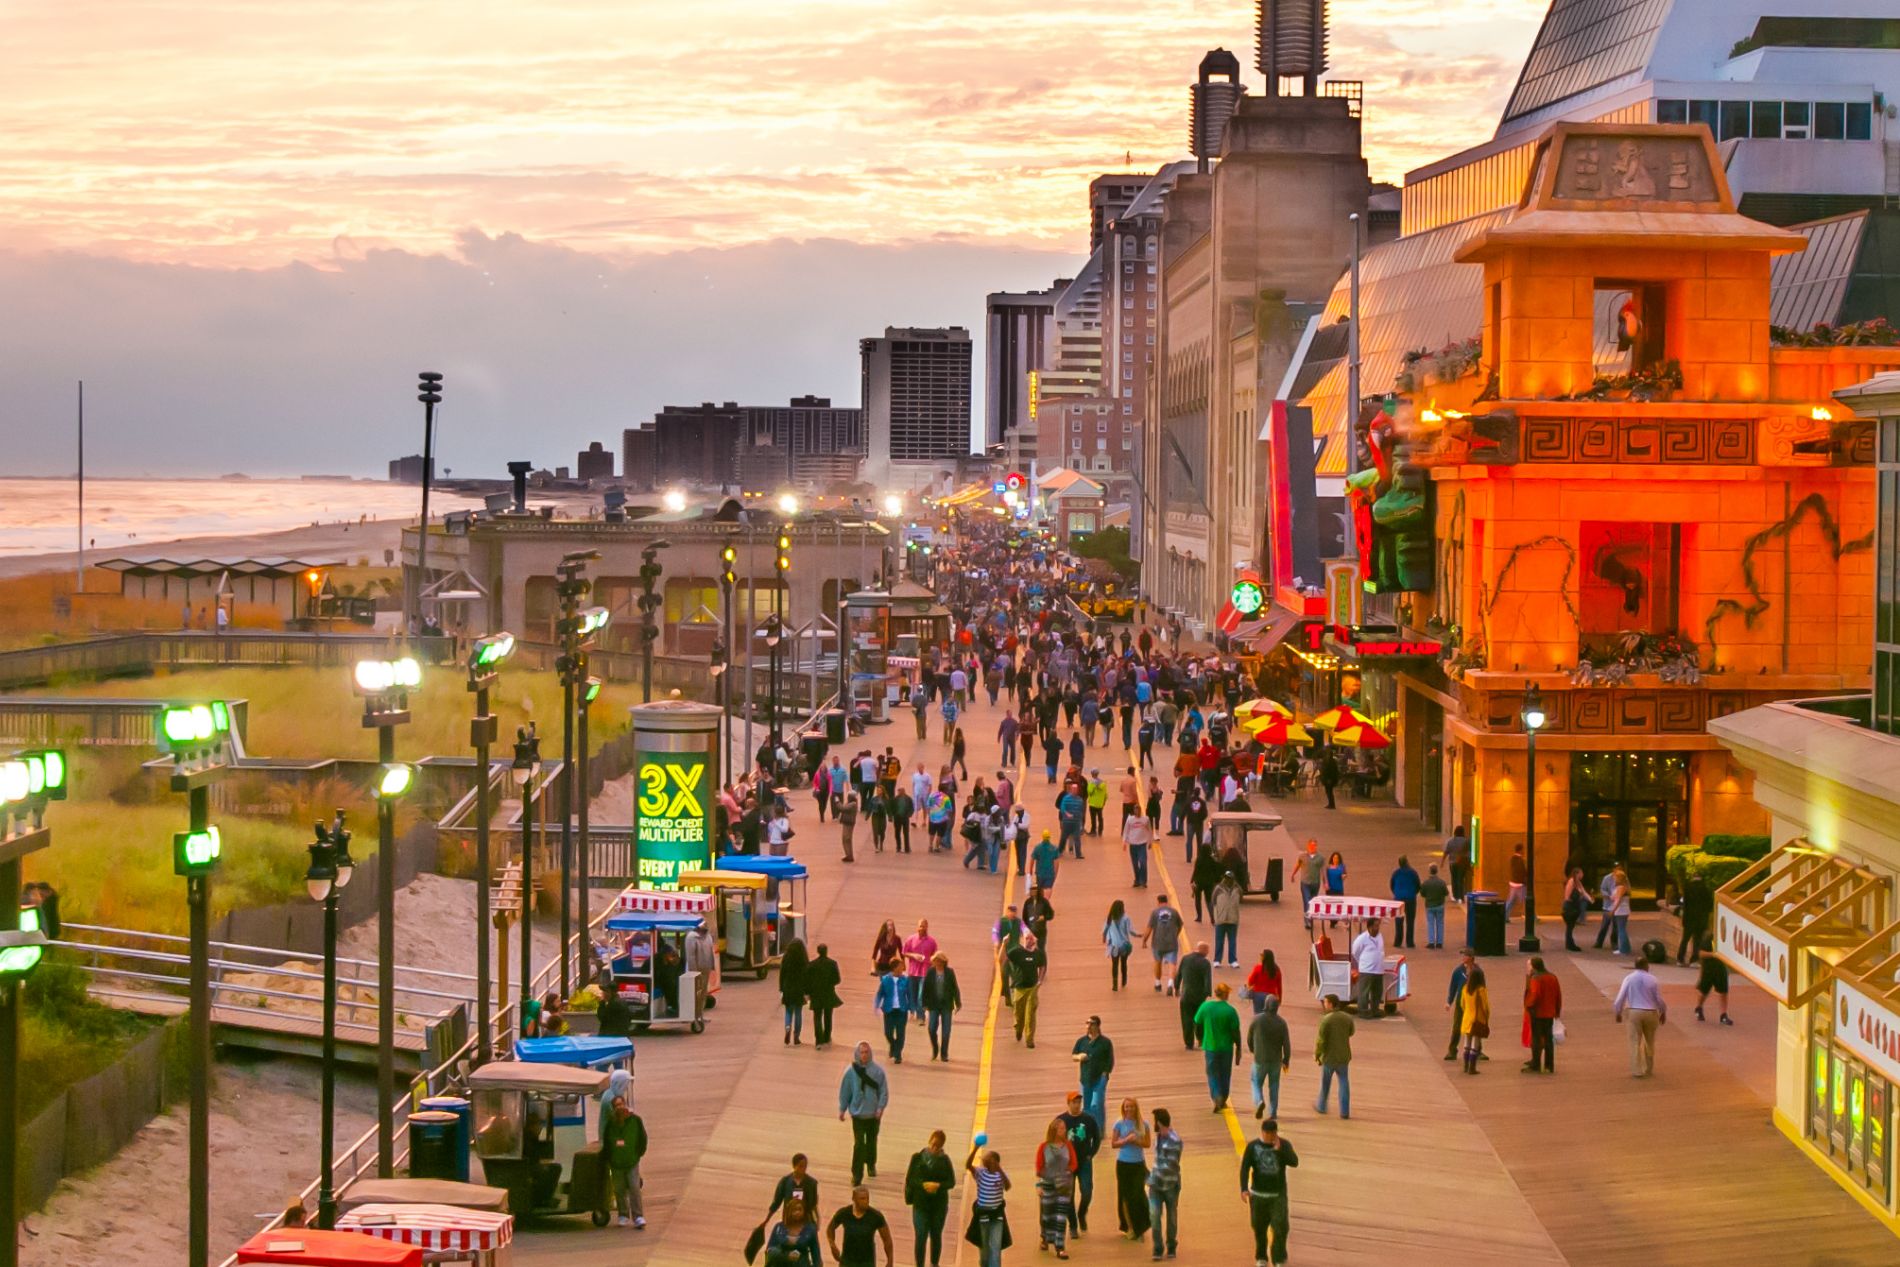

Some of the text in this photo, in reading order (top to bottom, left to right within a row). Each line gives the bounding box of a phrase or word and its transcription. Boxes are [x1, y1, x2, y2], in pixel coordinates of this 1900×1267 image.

[638, 764, 705, 817] 3X
[639, 818, 704, 828] REWARD CREDIT
[639, 828, 704, 842] MULTIPLIER
[639, 858, 702, 878] EVERY DAY
[1733, 924, 1771, 973] CAESARS
